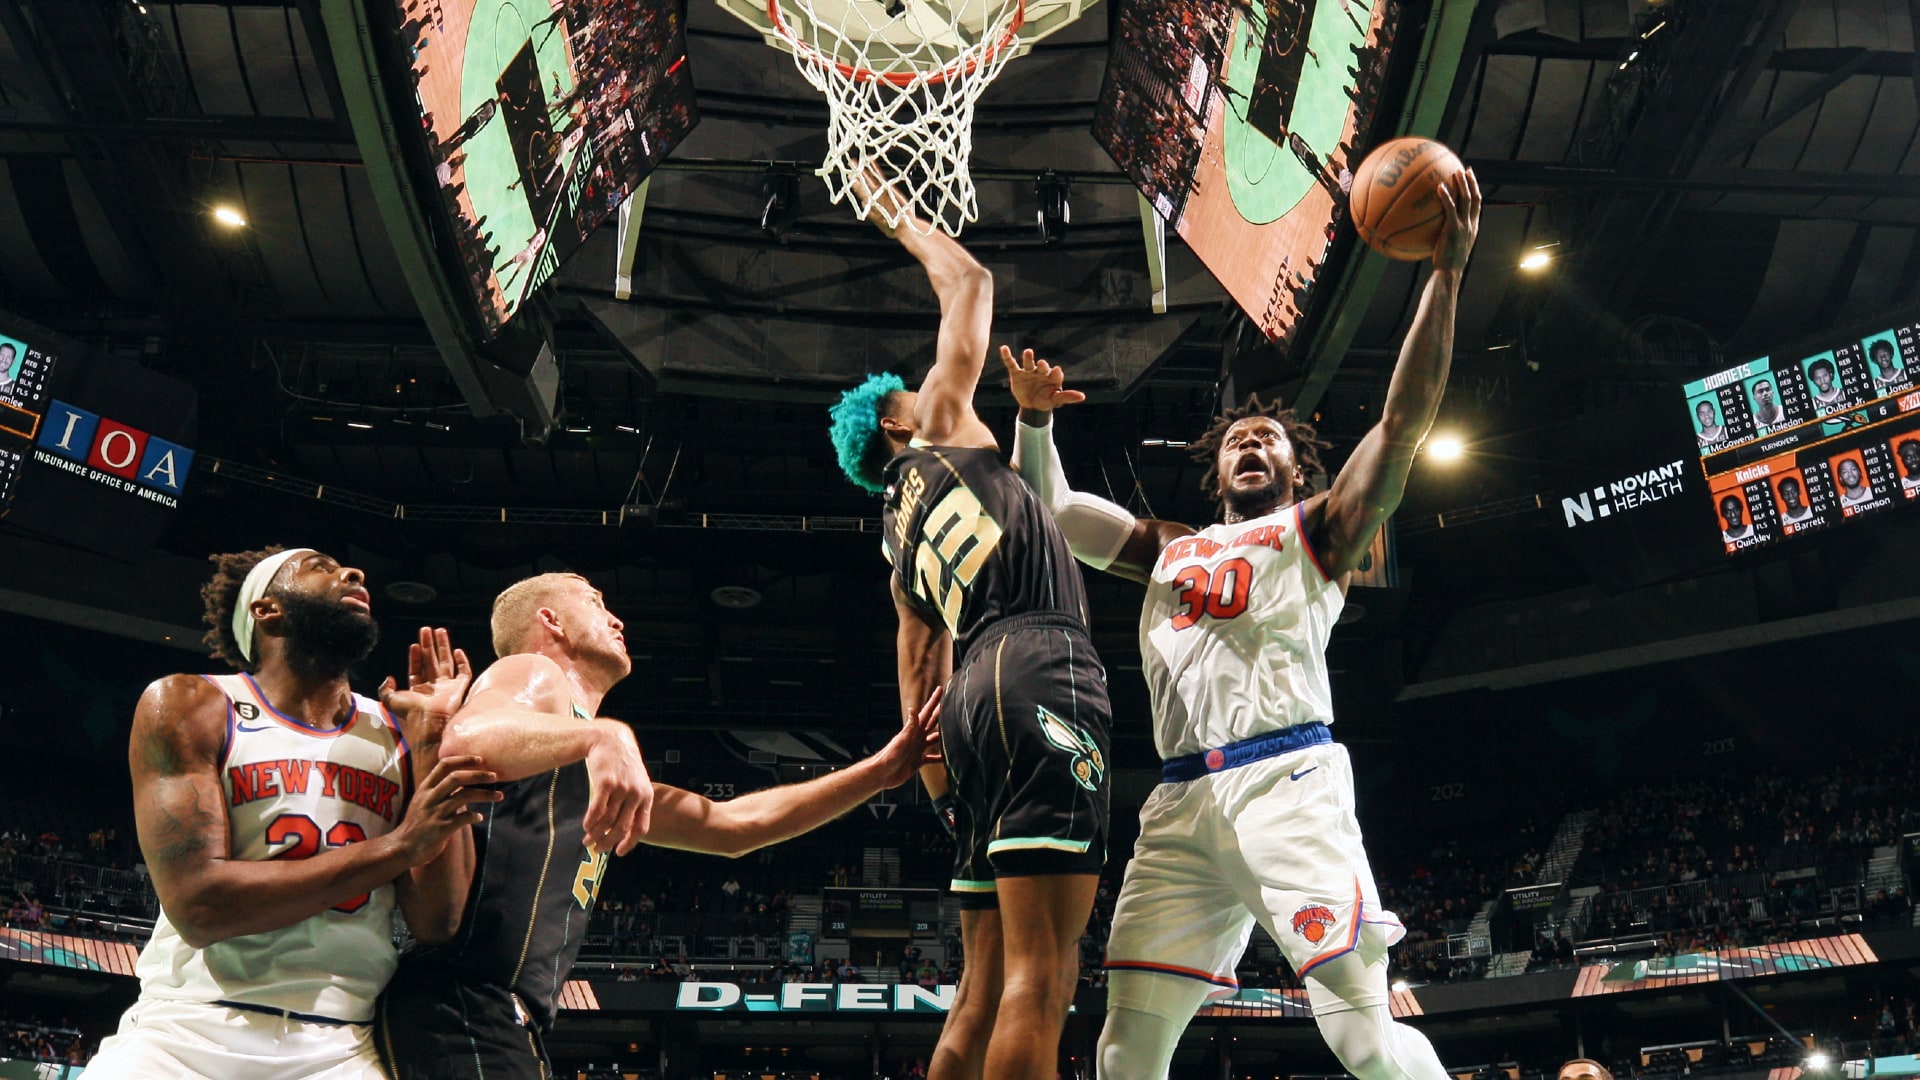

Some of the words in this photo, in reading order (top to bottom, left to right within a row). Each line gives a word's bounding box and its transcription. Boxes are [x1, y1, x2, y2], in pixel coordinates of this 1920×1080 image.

[1898, 327, 1910, 336] PTS
[29, 350, 41, 359] PTS
[1836, 348, 1848, 357] PTS
[1904, 346, 1915, 355] AST
[25, 359, 38, 369] REB
[1838, 358, 1851, 366] REB
[1906, 356, 1919, 365] BLK
[22, 369, 35, 378] AST
[1777, 369, 1789, 377] PTS
[1842, 367, 1853, 376] AST
[1703, 363, 1752, 391] HORNETS
[1844, 377, 1857, 385] BLK
[19, 378, 32, 388] BLK
[16, 387, 28, 397] FLS
[1720, 388, 1732, 397] PTS
[1783, 387, 1794, 396] AST
[1888, 381, 1914, 395] Jones
[1826, 401, 1852, 415] Oubre
[1855, 396, 1866, 406] Jr.
[1725, 407, 1736, 415] AST
[1879, 406, 1887, 415] 6
[1727, 417, 1740, 425] BLK
[1768, 417, 1804, 434] Maledon
[1710, 433, 1755, 453] McGowens
[1761, 435, 1799, 452] TURNOVERS
[56, 411, 178, 488] IOA
[1863, 447, 1877, 456] PTS
[1735, 464, 1770, 483] Knicks
[1804, 466, 1816, 475] PTS
[1869, 466, 1881, 475] AST
[34, 450, 88, 477] INSURANCE
[90, 470, 121, 489] OFFICE
[124, 482, 136, 493] OF
[138, 487, 178, 509] AMERICA
[1610, 459, 1684, 496] NOVANT
[1872, 475, 1886, 484] BLK
[1746, 485, 1758, 493] PTS
[1809, 485, 1821, 493] AST
[1614, 478, 1683, 513] HEALTH
[1812, 495, 1825, 503] BLK
[894, 466, 926, 549] JONES
[1751, 503, 1762, 511] AST
[1853, 497, 1891, 514] Brunson
[1753, 512, 1765, 521] BLK
[1794, 516, 1825, 531] Barrett
[1161, 537, 1224, 571] NEW
[1222, 525, 1287, 552] YORK
[1171, 557, 1254, 632] 30
[1702, 738, 1735, 756] 203
[230, 759, 314, 805] NEW
[315, 761, 400, 822] YORK
[704, 783, 735, 798] 233
[1431, 783, 1464, 801] 202
[1512, 891, 1540, 900] UTILITY
[676, 981, 957, 1011] D-FEN
